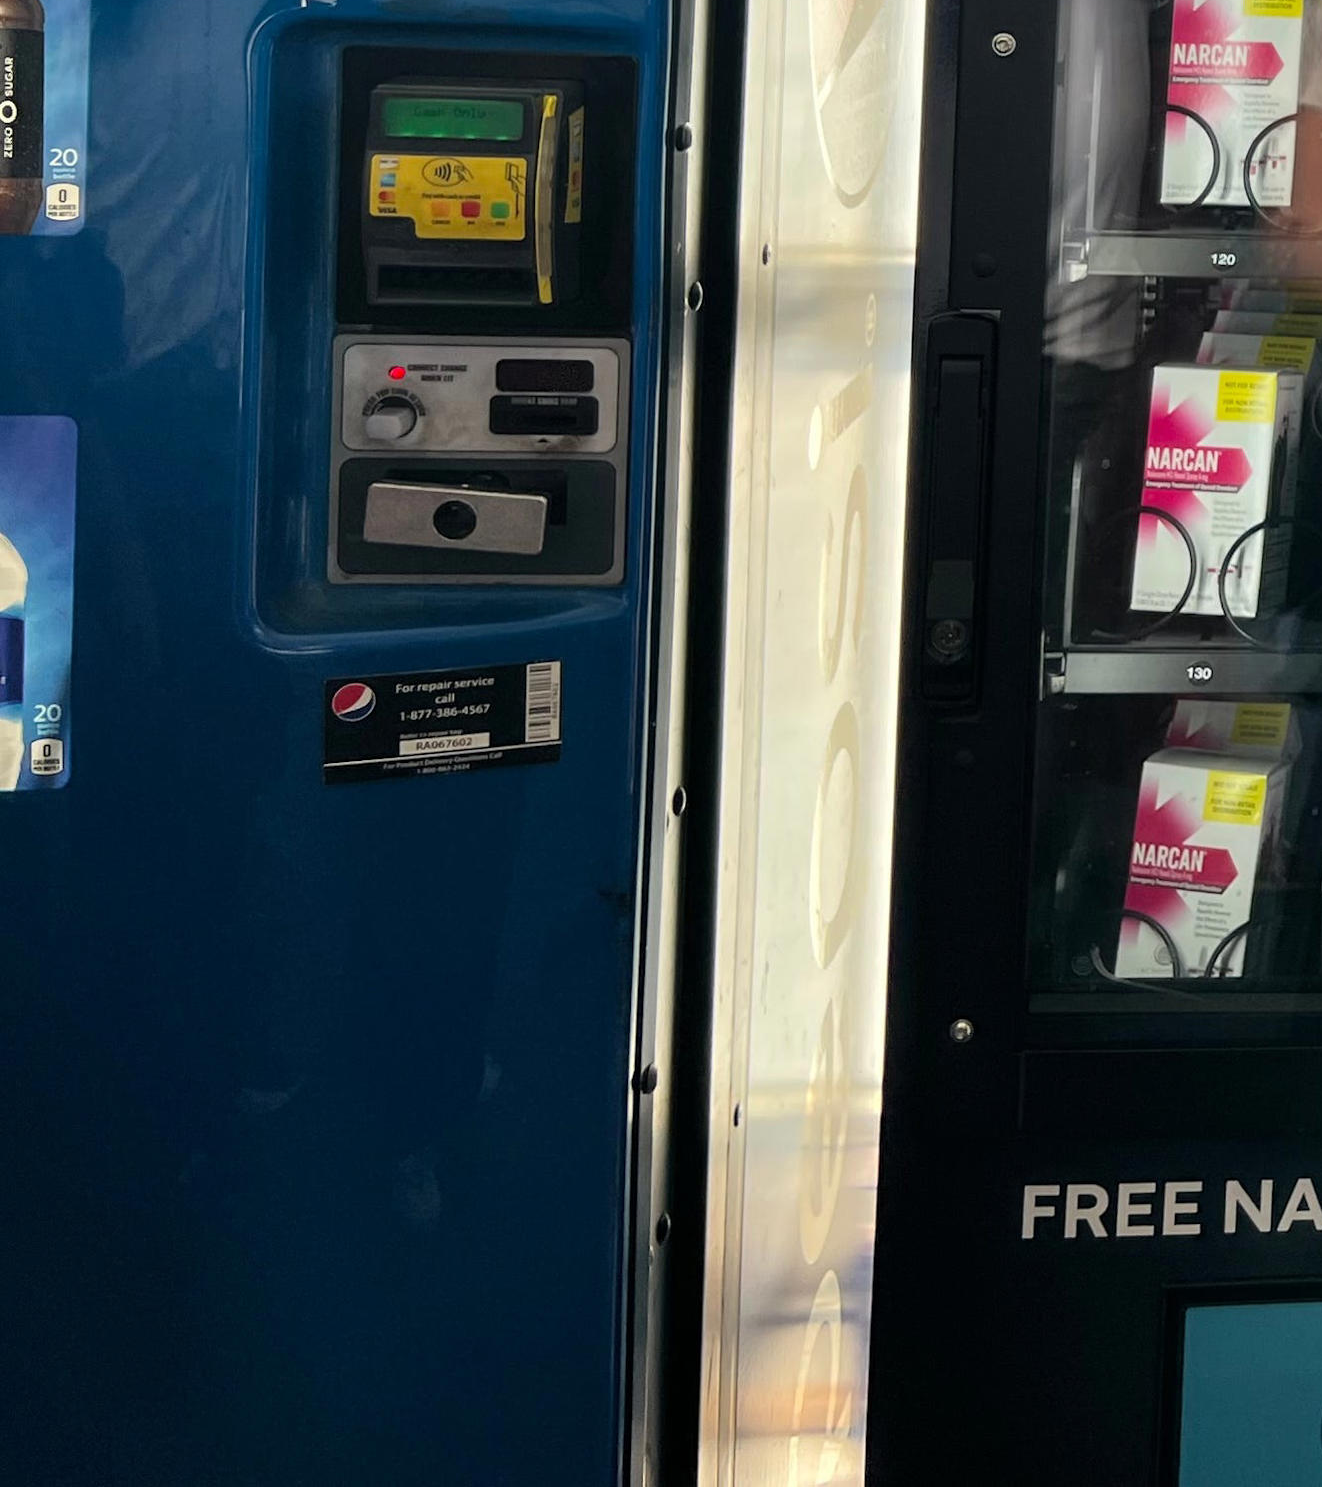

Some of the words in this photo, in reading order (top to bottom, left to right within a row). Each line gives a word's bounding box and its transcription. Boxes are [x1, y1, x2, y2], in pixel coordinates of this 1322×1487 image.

[1173, 42, 1248, 66] NARCAN
[4, 56, 14, 98] SUGAR
[3, 127, 13, 158] ZERO
[49, 148, 78, 166] 20
[58, 189, 67, 203] 0
[1210, 252, 1236, 266] 120
[1147, 446, 1219, 472] NARCAN
[1186, 667, 1213, 680] 130
[396, 684, 415, 693] For
[417, 680, 452, 692] repair
[454, 677, 494, 689] service
[435, 693, 455, 704] call
[33, 704, 62, 723] 20
[401, 704, 490, 721] 1-877-386-4567
[43, 744, 51, 757] 0
[416, 738, 472, 750] RA067602
[1132, 842, 1204, 873] NARCAN
[1021, 1181, 1203, 1240] FREE
